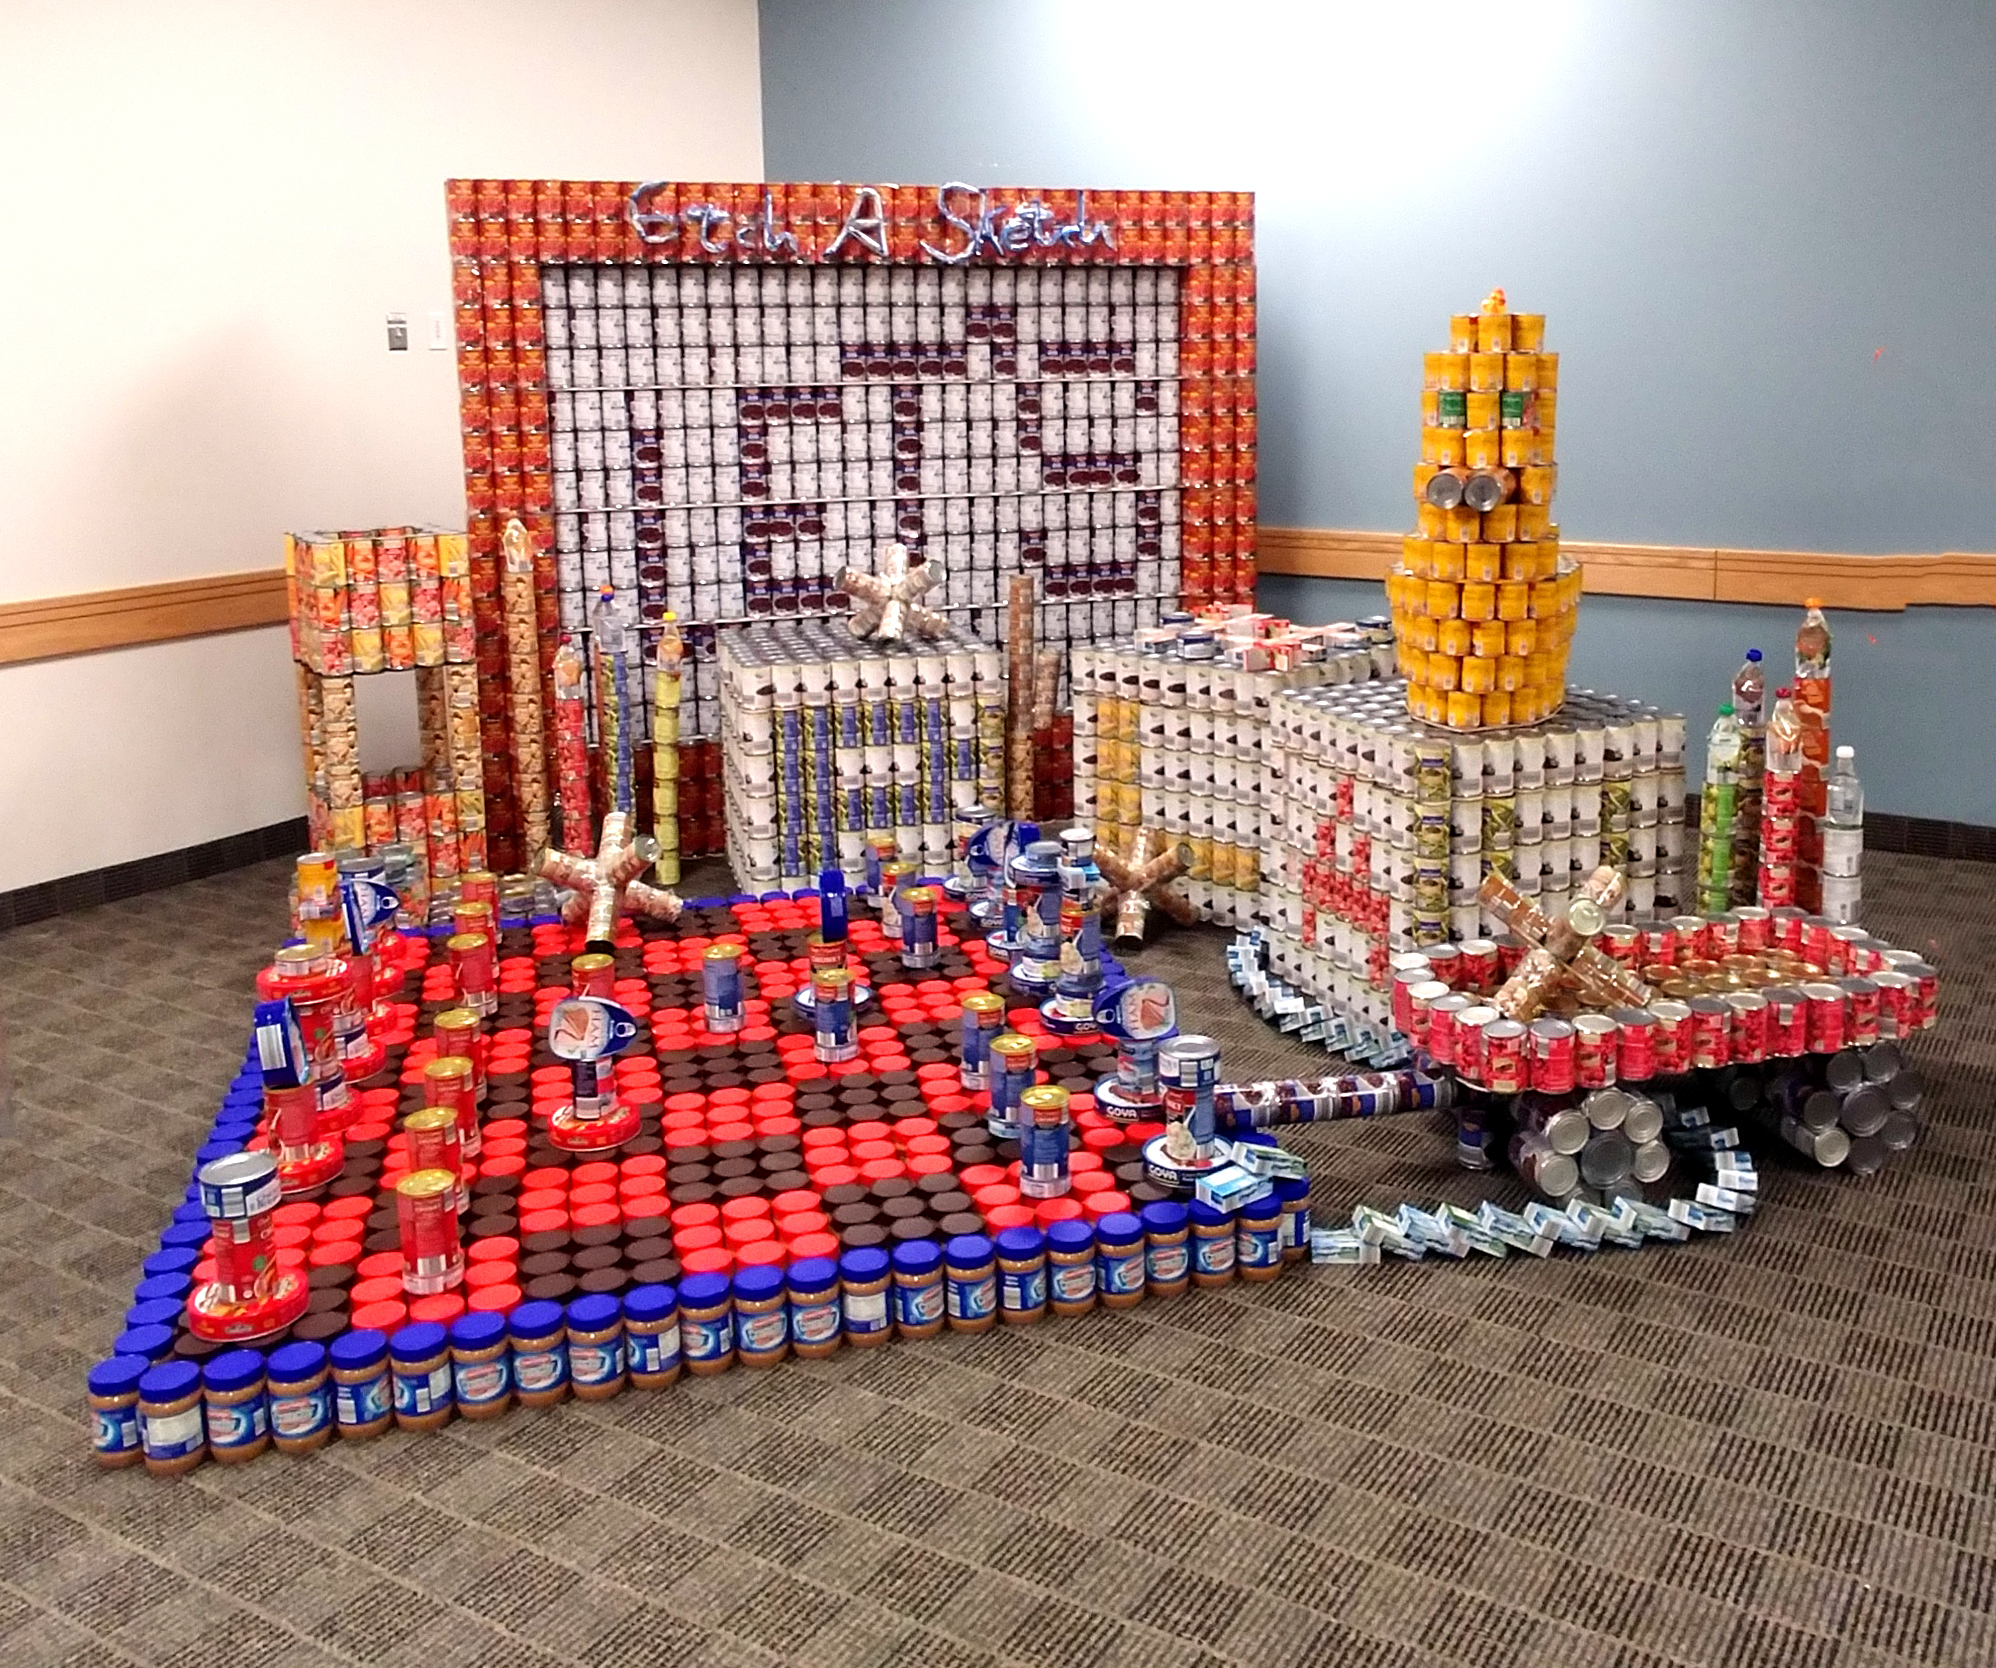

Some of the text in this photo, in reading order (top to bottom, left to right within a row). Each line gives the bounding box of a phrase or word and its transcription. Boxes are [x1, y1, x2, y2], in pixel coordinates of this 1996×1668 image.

[627, 180, 799, 254] Etch
[822, 186, 890, 258] A
[1106, 1105, 1138, 1119] GOYA
[1148, 1164, 1178, 1181] GOYA
